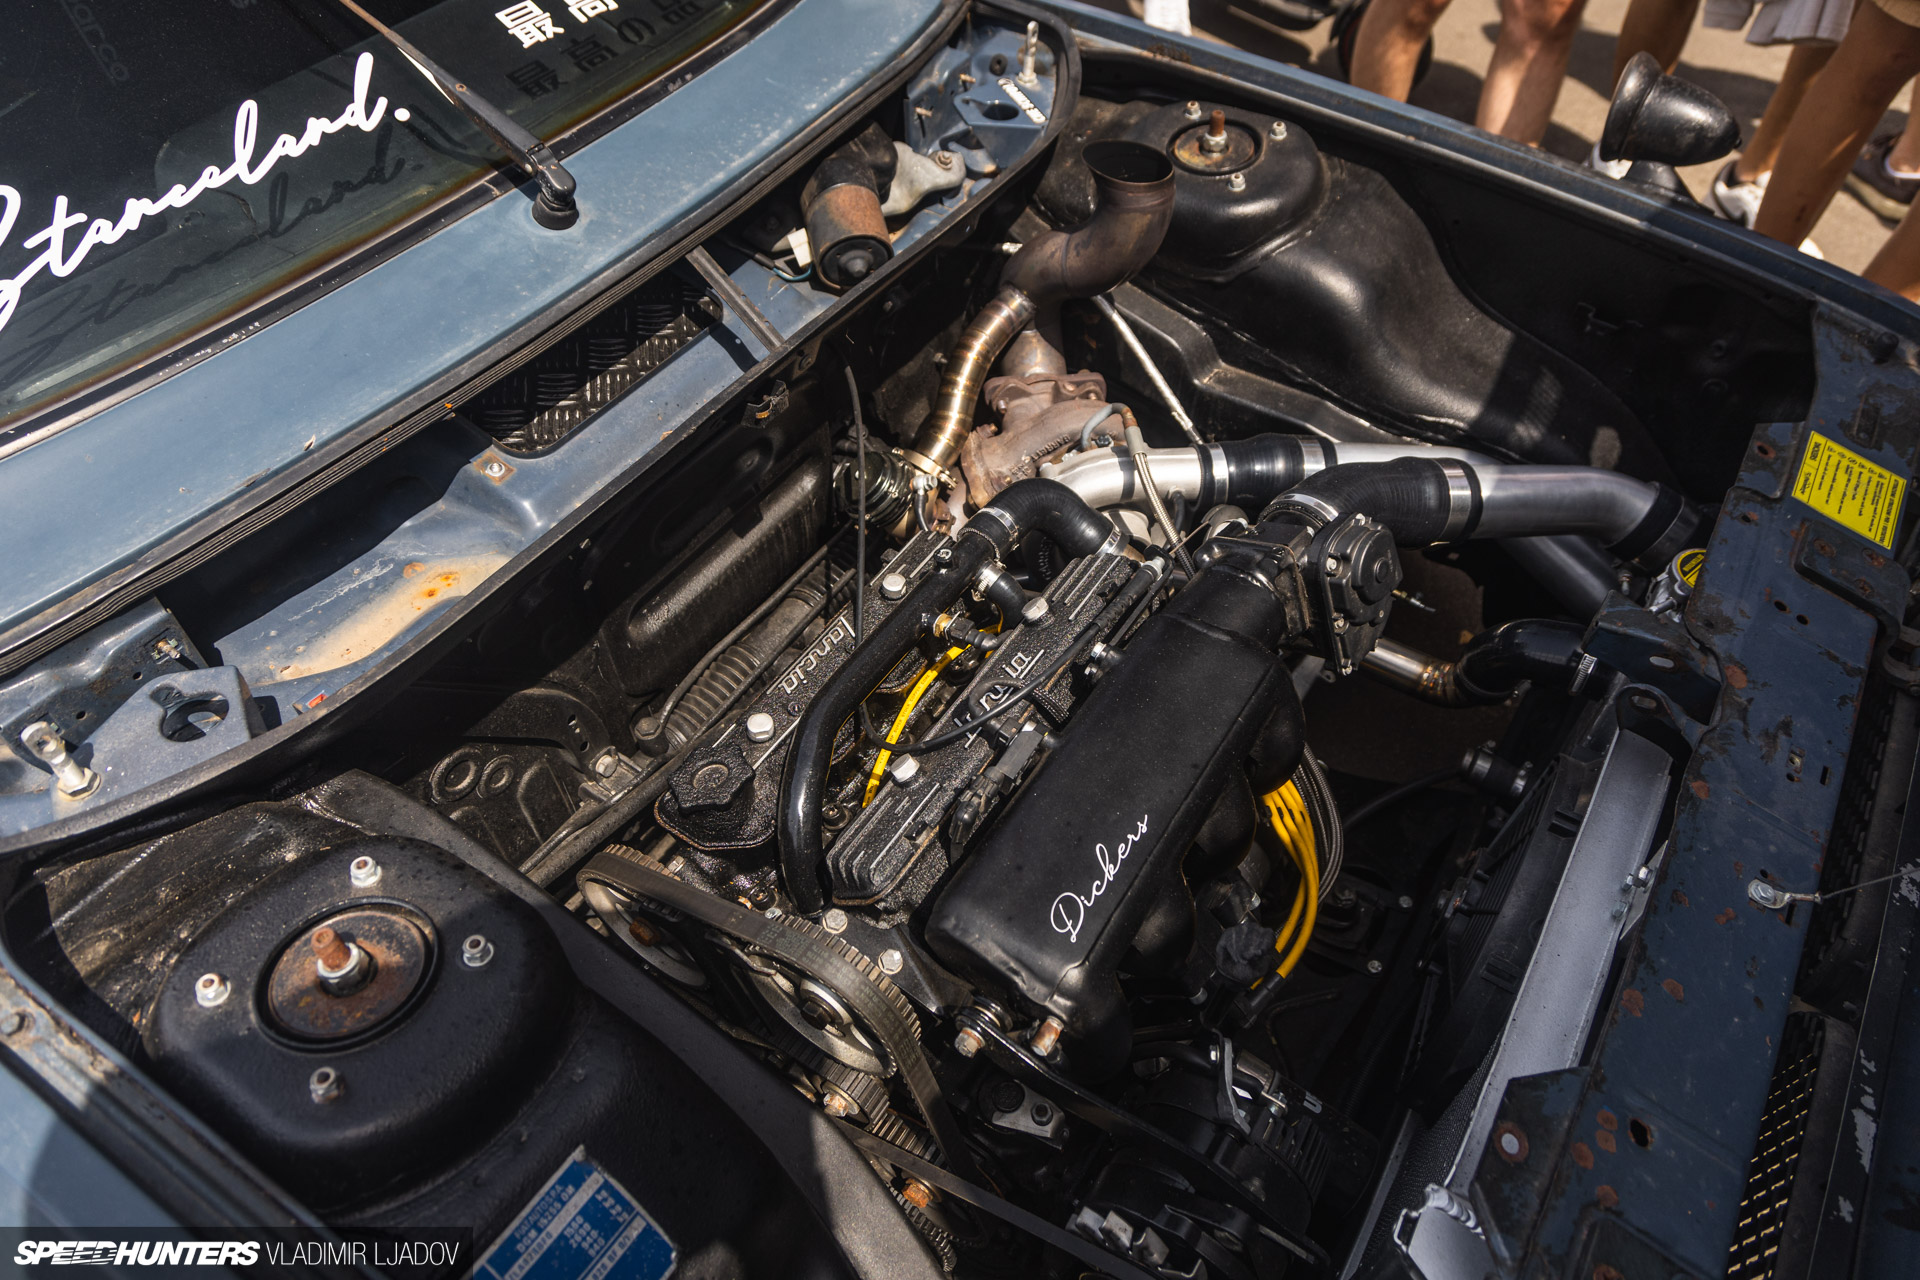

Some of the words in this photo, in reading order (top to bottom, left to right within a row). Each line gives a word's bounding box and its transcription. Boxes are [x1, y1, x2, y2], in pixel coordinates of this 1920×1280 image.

[767, 610, 856, 694] Lancia
[954, 649, 1044, 748] Lncia
[1050, 814, 1148, 943] Dickers
